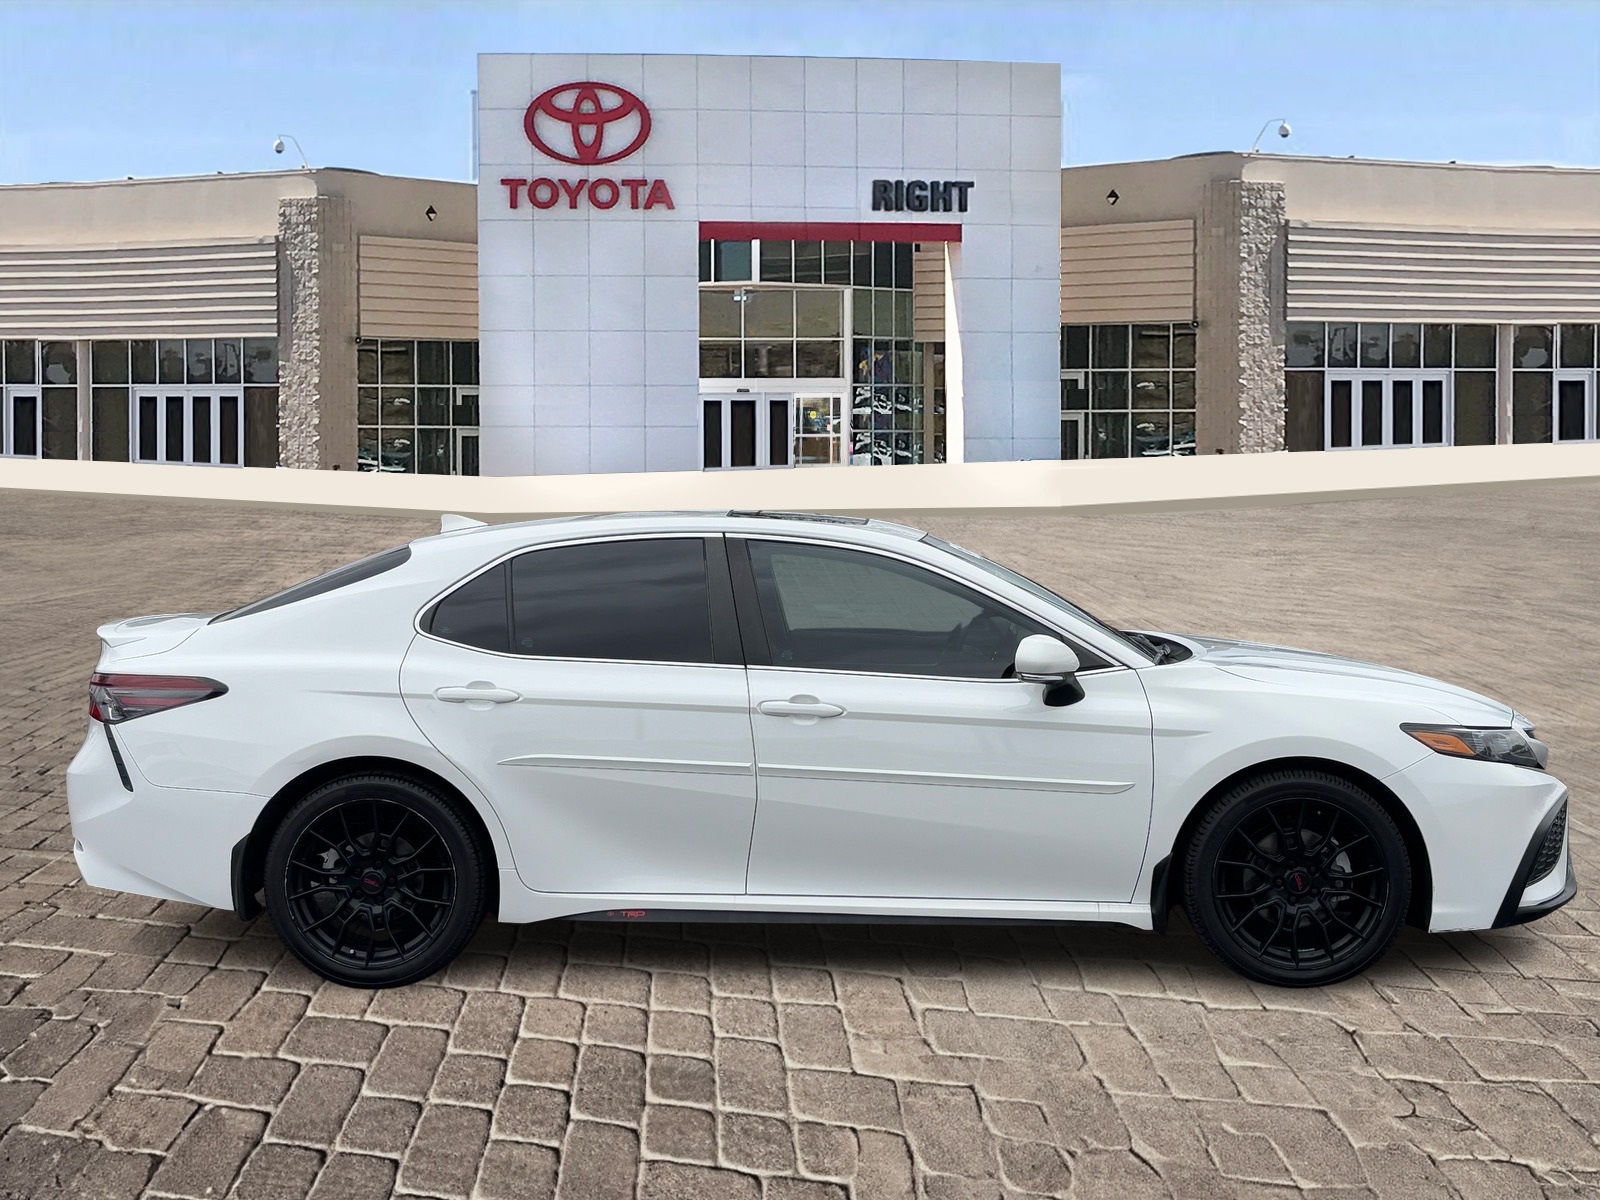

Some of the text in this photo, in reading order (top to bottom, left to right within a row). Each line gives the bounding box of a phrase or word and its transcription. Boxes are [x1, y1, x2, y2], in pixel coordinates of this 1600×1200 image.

[501, 178, 675, 210] TOYOTA
[872, 179, 975, 212] RIGHT
[620, 910, 646, 918] TRD
